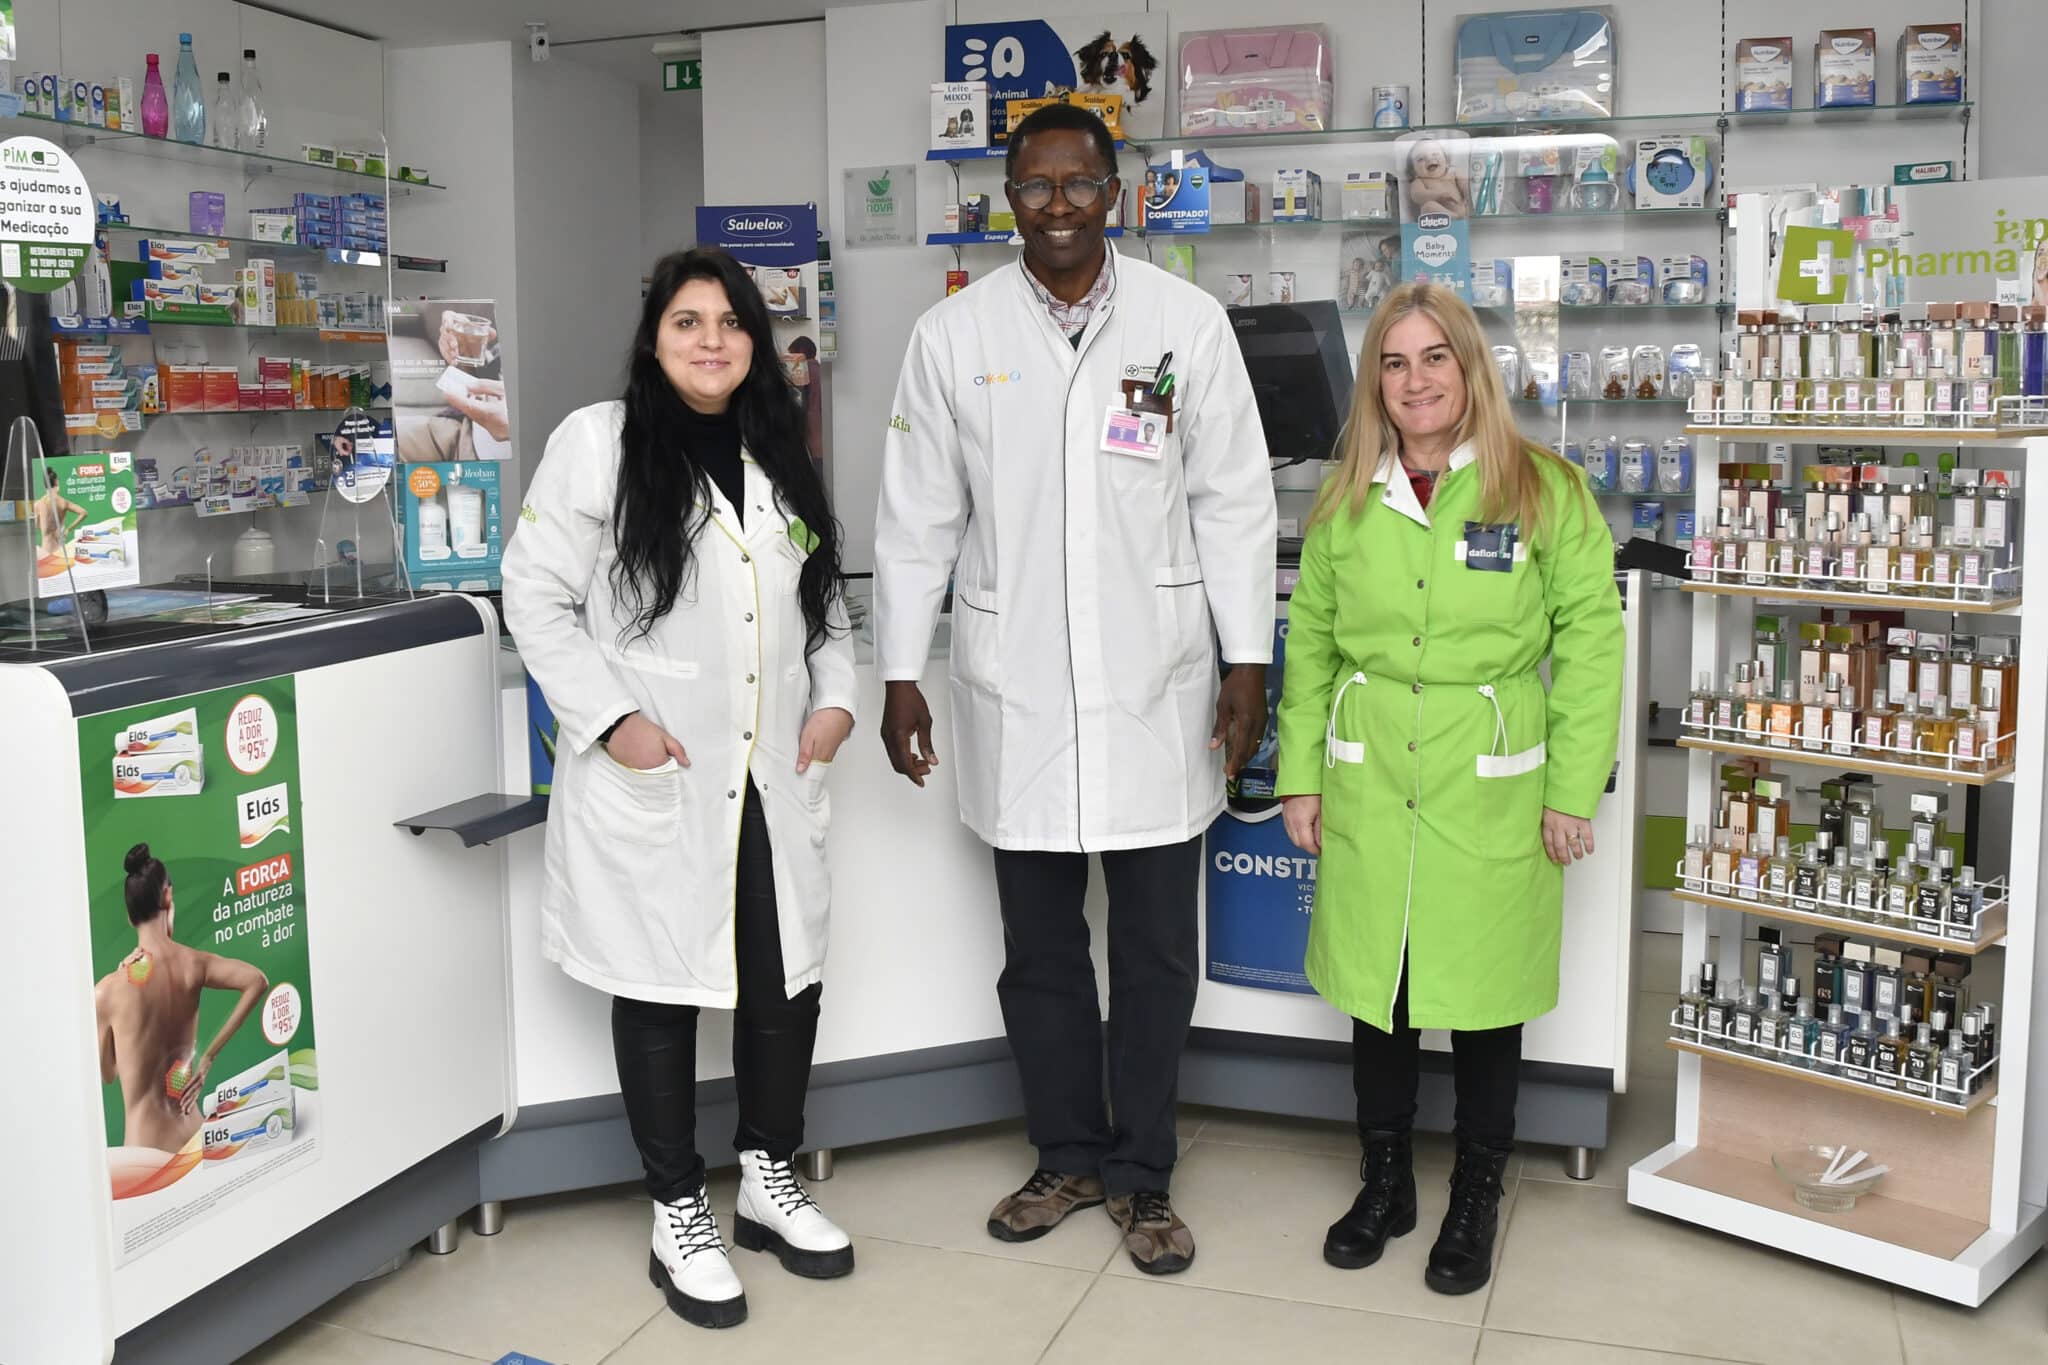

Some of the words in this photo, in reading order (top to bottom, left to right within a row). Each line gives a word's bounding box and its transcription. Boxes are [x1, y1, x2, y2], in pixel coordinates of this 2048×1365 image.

[995, 89, 1028, 98] Animal
[1914, 166, 1942, 175] HALIBUT
[10, 178, 70, 194] ajudamos
[74, 186, 82, 196] a
[49, 204, 57, 214] a
[61, 204, 82, 216] sua
[1148, 210, 1208, 219] CONSTIPADO?
[1, 219, 69, 238] Medicação
[727, 218, 784, 230] Salvelox
[1426, 242, 1445, 250] Baby
[1416, 250, 1454, 258] Moments
[1866, 247, 2016, 280] Pharma
[1879, 390, 1889, 398] 10
[1976, 390, 1985, 398] 14
[72, 468, 78, 476] A
[79, 465, 104, 476] FORÇA
[66, 476, 76, 486] da
[77, 476, 106, 486] natureza
[77, 485, 106, 494] combate
[238, 708, 262, 726] REDUZ
[129, 729, 148, 743] Elás
[240, 728, 244, 740] A
[246, 724, 262, 740] DOR
[116, 764, 140, 778] Elás
[246, 796, 280, 820] Elás
[223, 877, 234, 897] A
[240, 858, 290, 890] FORÇA
[1774, 872, 1784, 880] 50
[1830, 880, 1840, 888] 52
[213, 902, 230, 922] da
[234, 882, 292, 915] natureza
[215, 926, 232, 944] no
[236, 904, 294, 936] combate
[262, 928, 270, 948] à
[273, 922, 296, 943] dor
[272, 992, 290, 1009] REDUZ
[278, 1004, 289, 1020] DOR
[1912, 1058, 1924, 1068] 70
[217, 1084, 238, 1103] Elás
[204, 1126, 230, 1146] Elás
